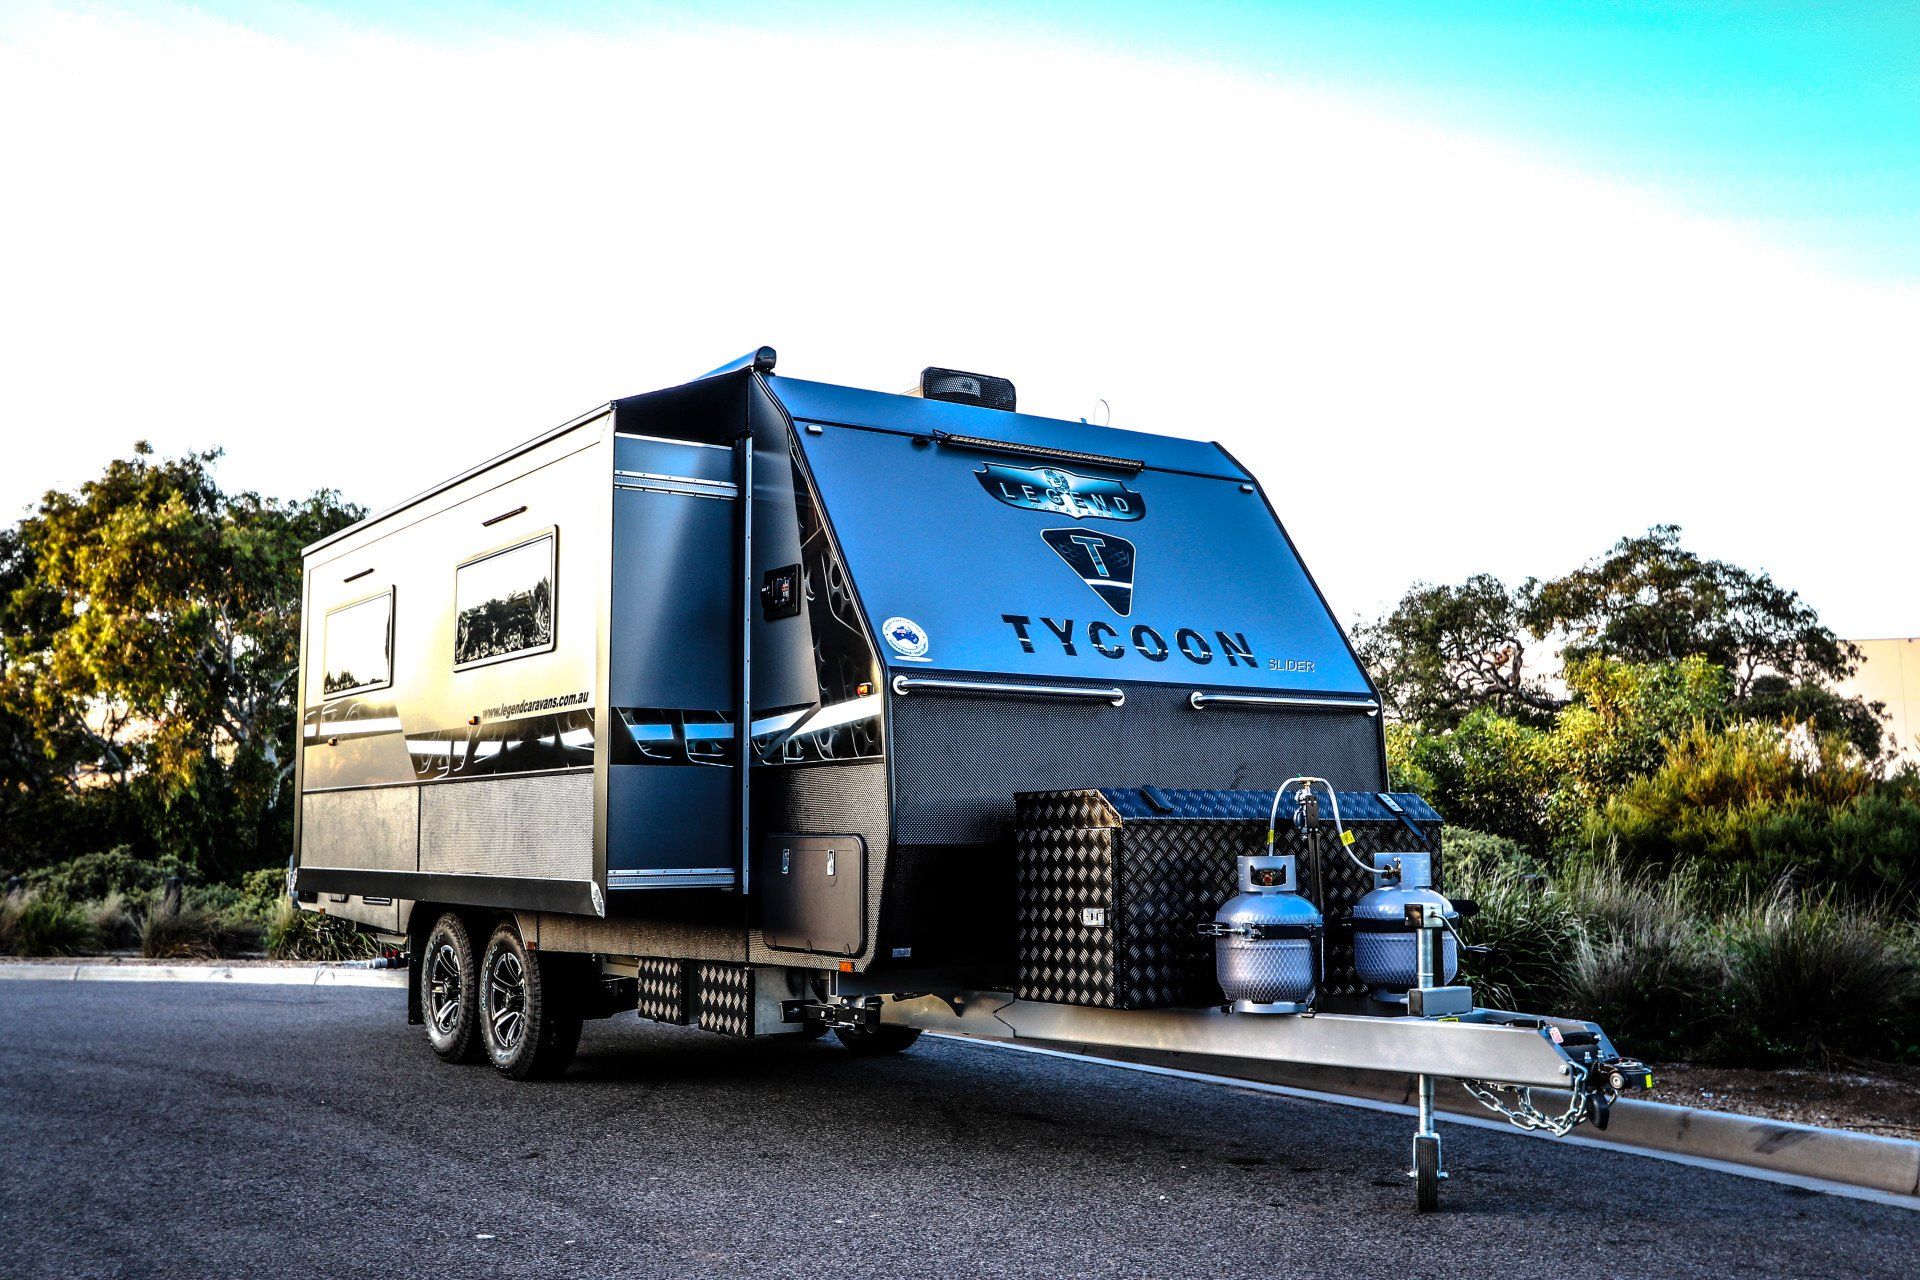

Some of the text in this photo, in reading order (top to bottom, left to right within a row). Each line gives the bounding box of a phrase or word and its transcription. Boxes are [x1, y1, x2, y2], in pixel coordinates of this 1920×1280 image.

[999, 482, 1130, 514] LEGEND
[1069, 534, 1110, 578] T
[1000, 613, 1316, 673] TYCOON SLIDER
[482, 691, 590, 719] www.legendcaravans.com.au
